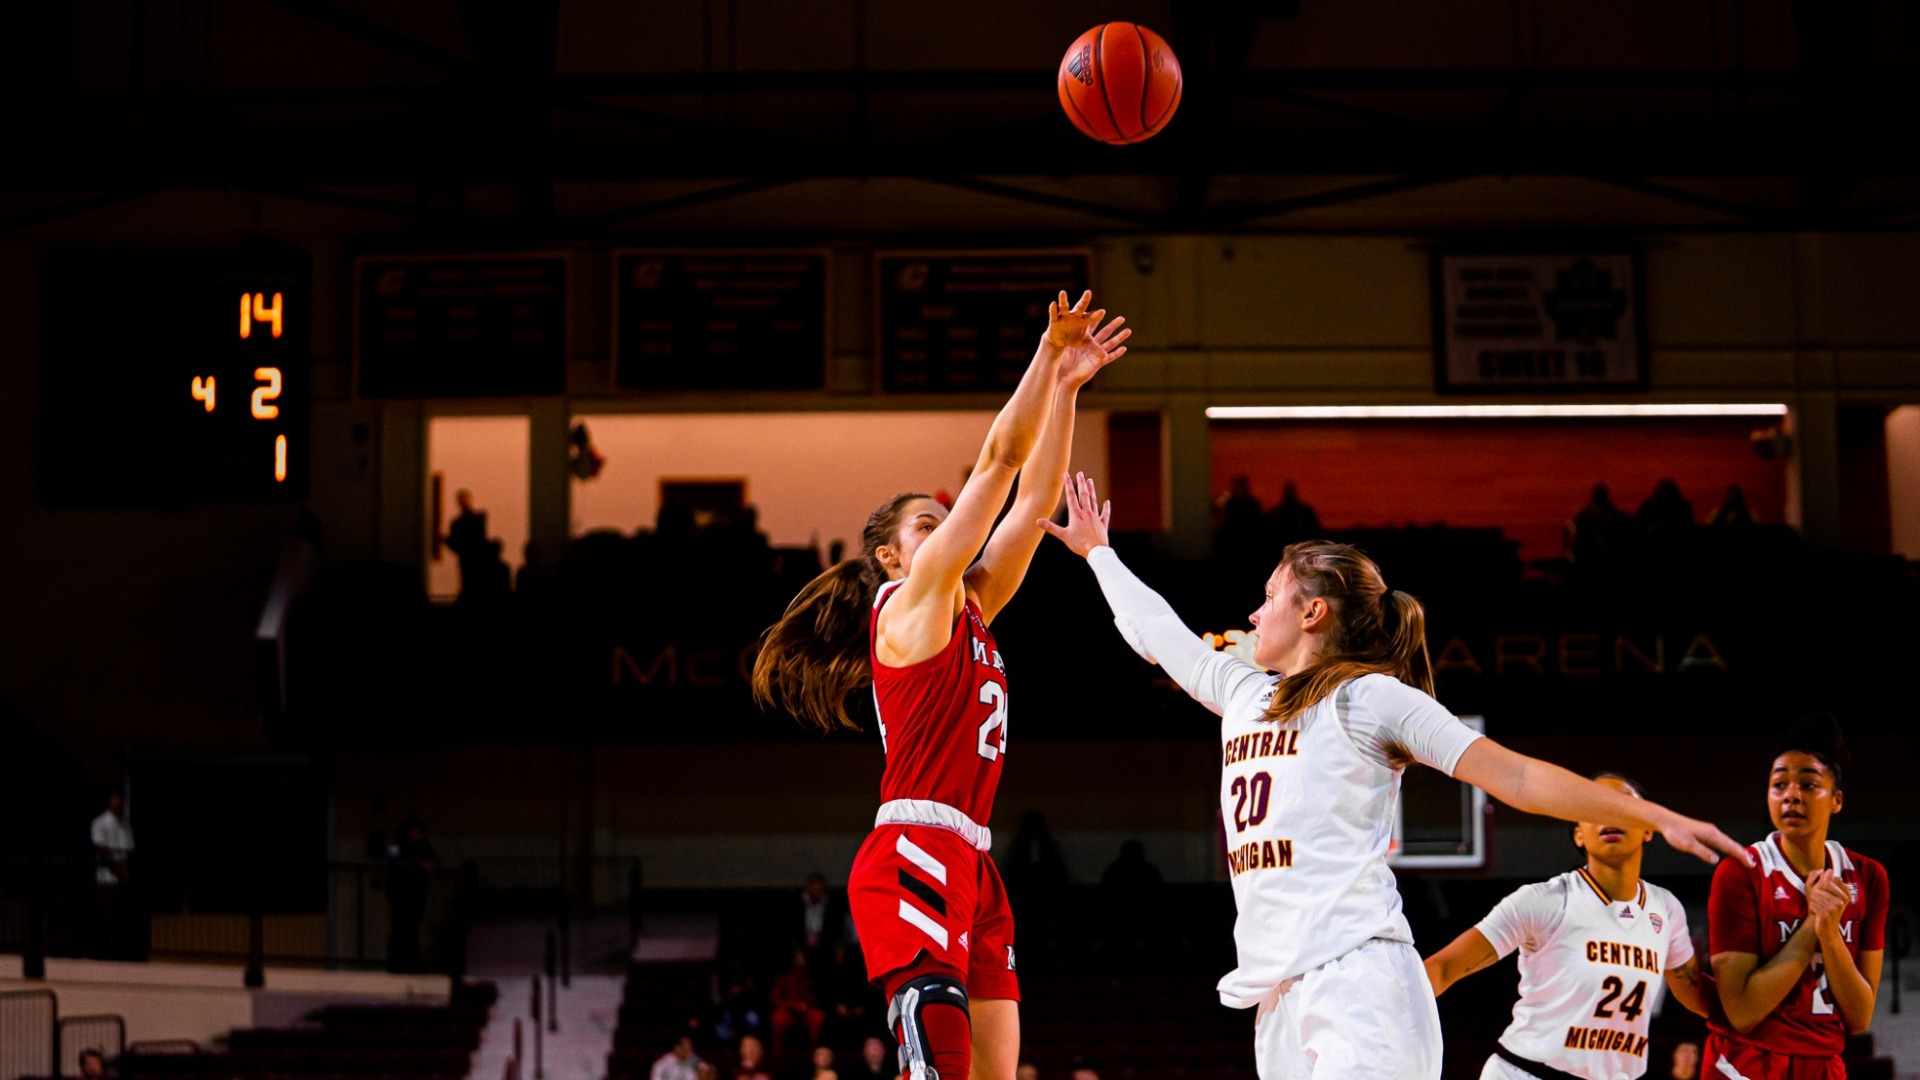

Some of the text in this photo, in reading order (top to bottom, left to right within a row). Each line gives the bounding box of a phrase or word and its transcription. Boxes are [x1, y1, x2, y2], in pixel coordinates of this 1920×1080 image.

[239, 291, 284, 340] 14
[190, 374, 217, 413] 4
[250, 366, 283, 420] 2
[274, 433, 288, 482] 1
[1436, 631, 1729, 678] ARENA
[1225, 729, 1299, 767] CENTRAL
[1231, 771, 1272, 833] 20
[1586, 941, 1660, 975] CENTRAL
[1593, 975, 1648, 1022] 24
[1564, 1026, 1649, 1058] MICHIGAN
